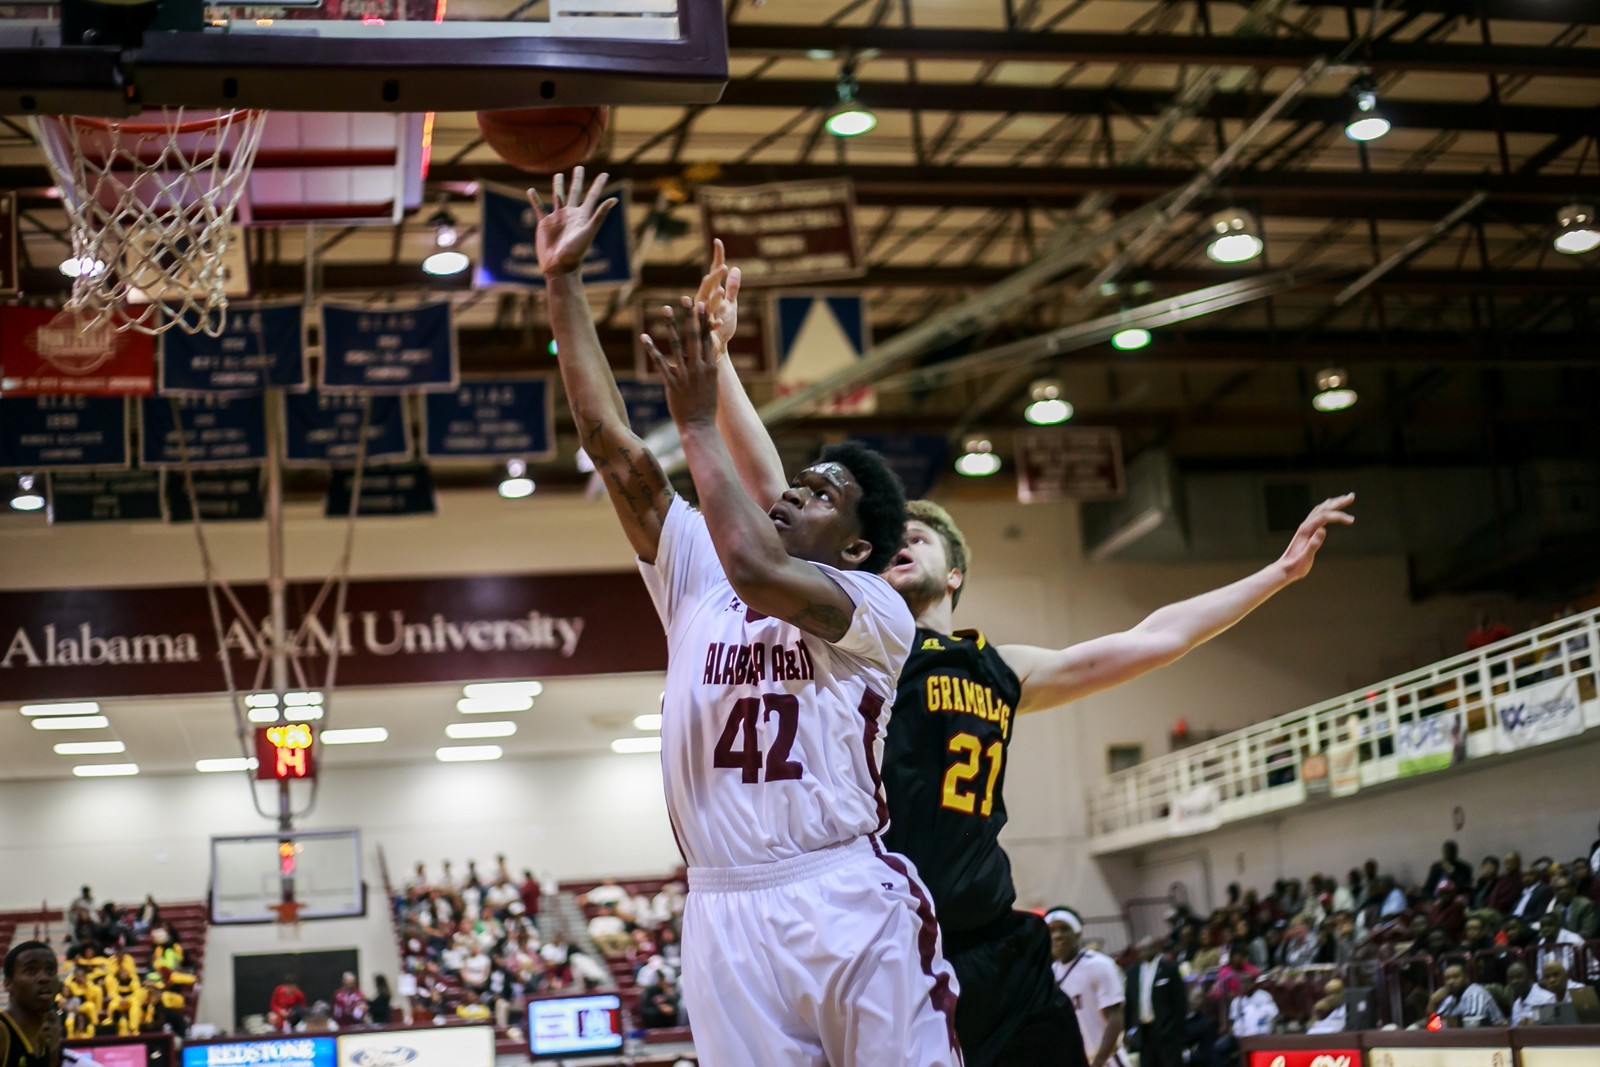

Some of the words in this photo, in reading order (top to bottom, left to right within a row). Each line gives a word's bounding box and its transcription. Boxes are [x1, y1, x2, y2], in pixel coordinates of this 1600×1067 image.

[1, 624, 199, 667] Alabama
[362, 609, 585, 658] University
[713, 692, 804, 784] 42
[941, 732, 1004, 818] 21
